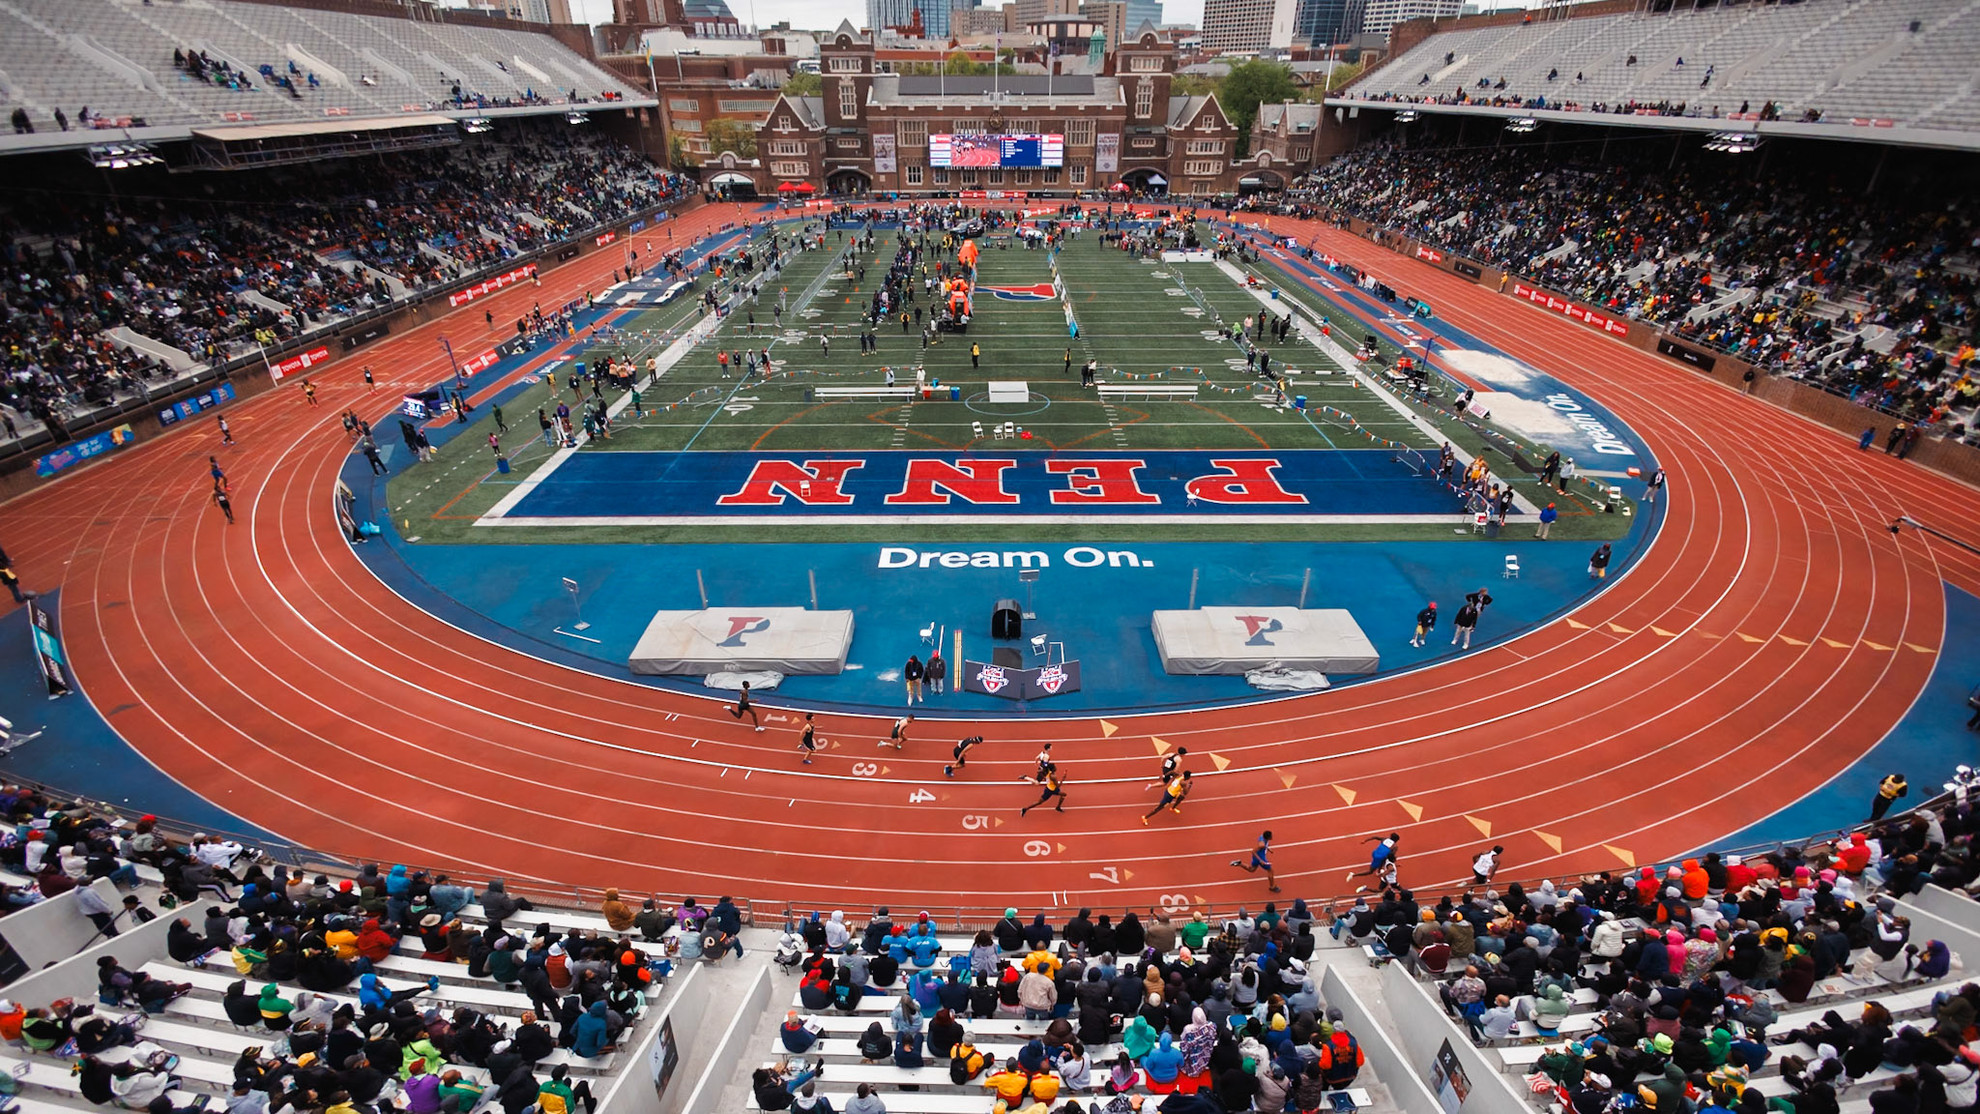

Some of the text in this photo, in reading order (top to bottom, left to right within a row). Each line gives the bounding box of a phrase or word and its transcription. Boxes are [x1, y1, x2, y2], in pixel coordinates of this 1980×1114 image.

[282, 350, 328, 372] TOYOTA TOYOTA
[1546, 393, 1583, 412] On.
[1566, 412, 1636, 456] Dream
[715, 458, 1310, 506] PENN
[878, 546, 1154, 569] Dream On.
[764, 713, 787, 722] 1
[812, 737, 828, 750] 2
[851, 762, 878, 777] 3
[909, 788, 937, 803] 4
[961, 814, 989, 830] 5
[1023, 840, 1051, 857] 6
[1089, 867, 1120, 884] 7
[1160, 894, 1190, 913] 8
